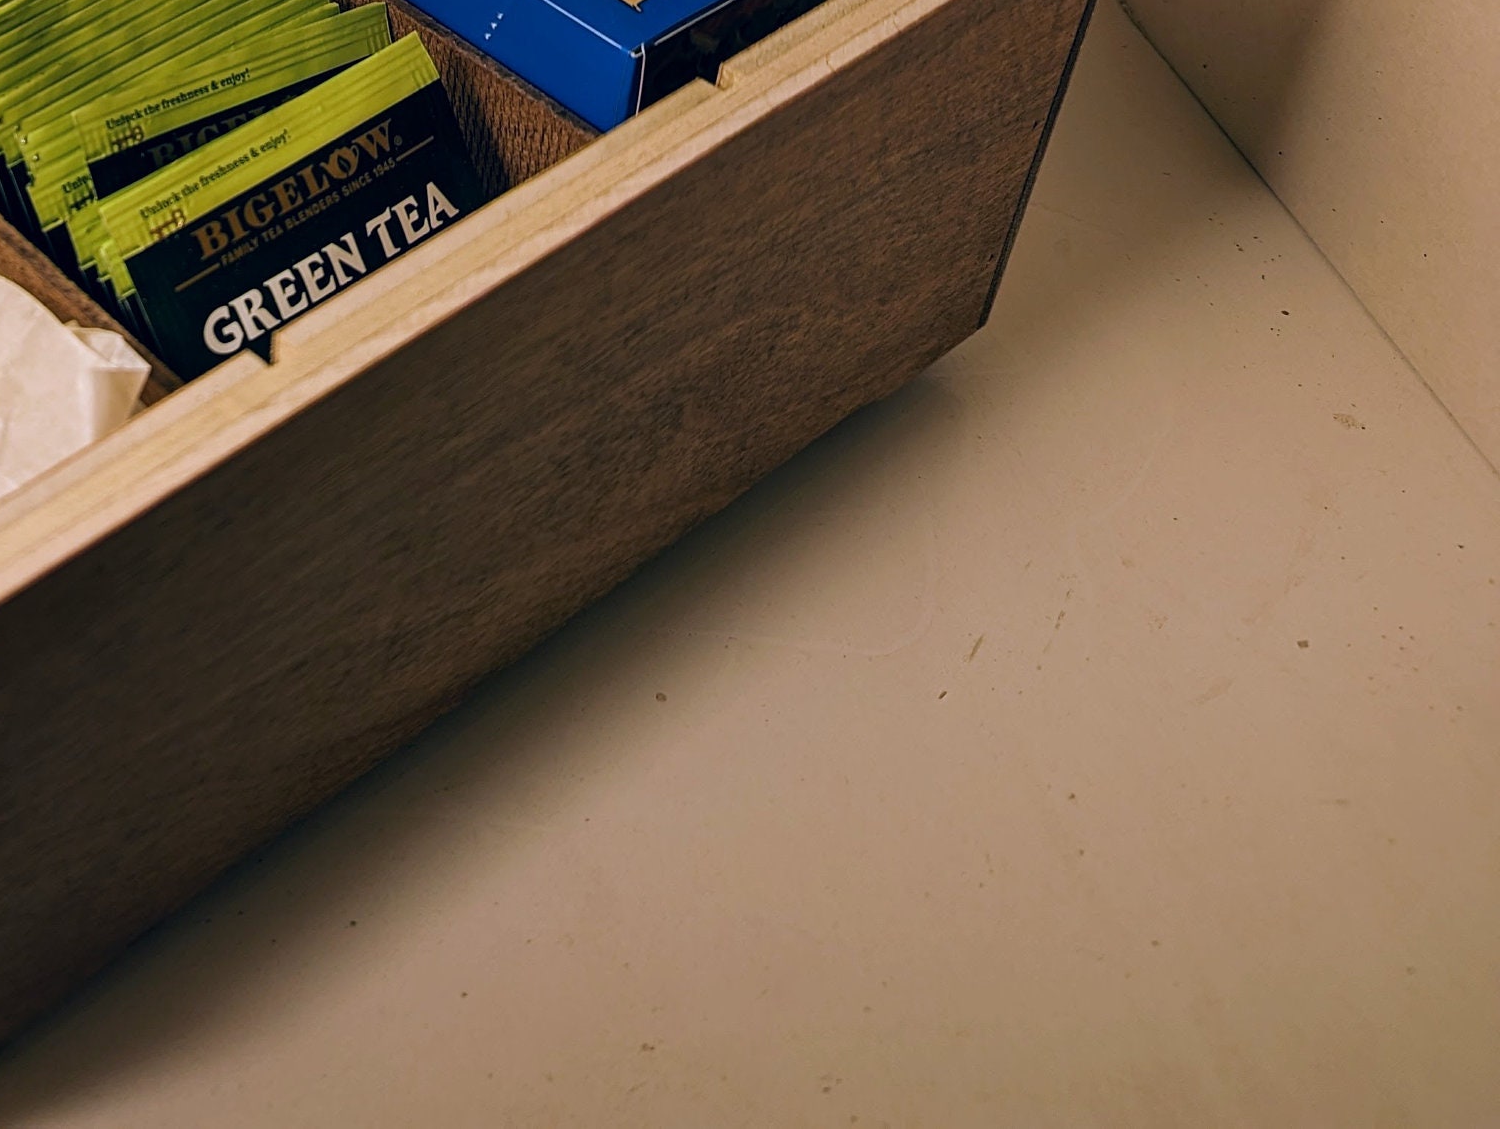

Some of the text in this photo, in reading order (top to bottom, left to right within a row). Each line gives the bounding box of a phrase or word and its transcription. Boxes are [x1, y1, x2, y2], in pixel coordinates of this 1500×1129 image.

[143, 103, 161, 116] the
[159, 84, 210, 110] freshness
[210, 79, 220, 91] &
[219, 67, 251, 88] enjoy!
[180, 181, 201, 199] the
[198, 153, 251, 188] freshness
[249, 147, 261, 158] &
[259, 128, 292, 153] enjoy!
[190, 117, 403, 261] BIGELOW
[220, 235, 259, 267] FAMILY
[259, 224, 285, 243] TEA
[284, 190, 341, 231] BLENDERS
[341, 171, 373, 197] SINCE
[203, 181, 460, 355] GREEN TEA
